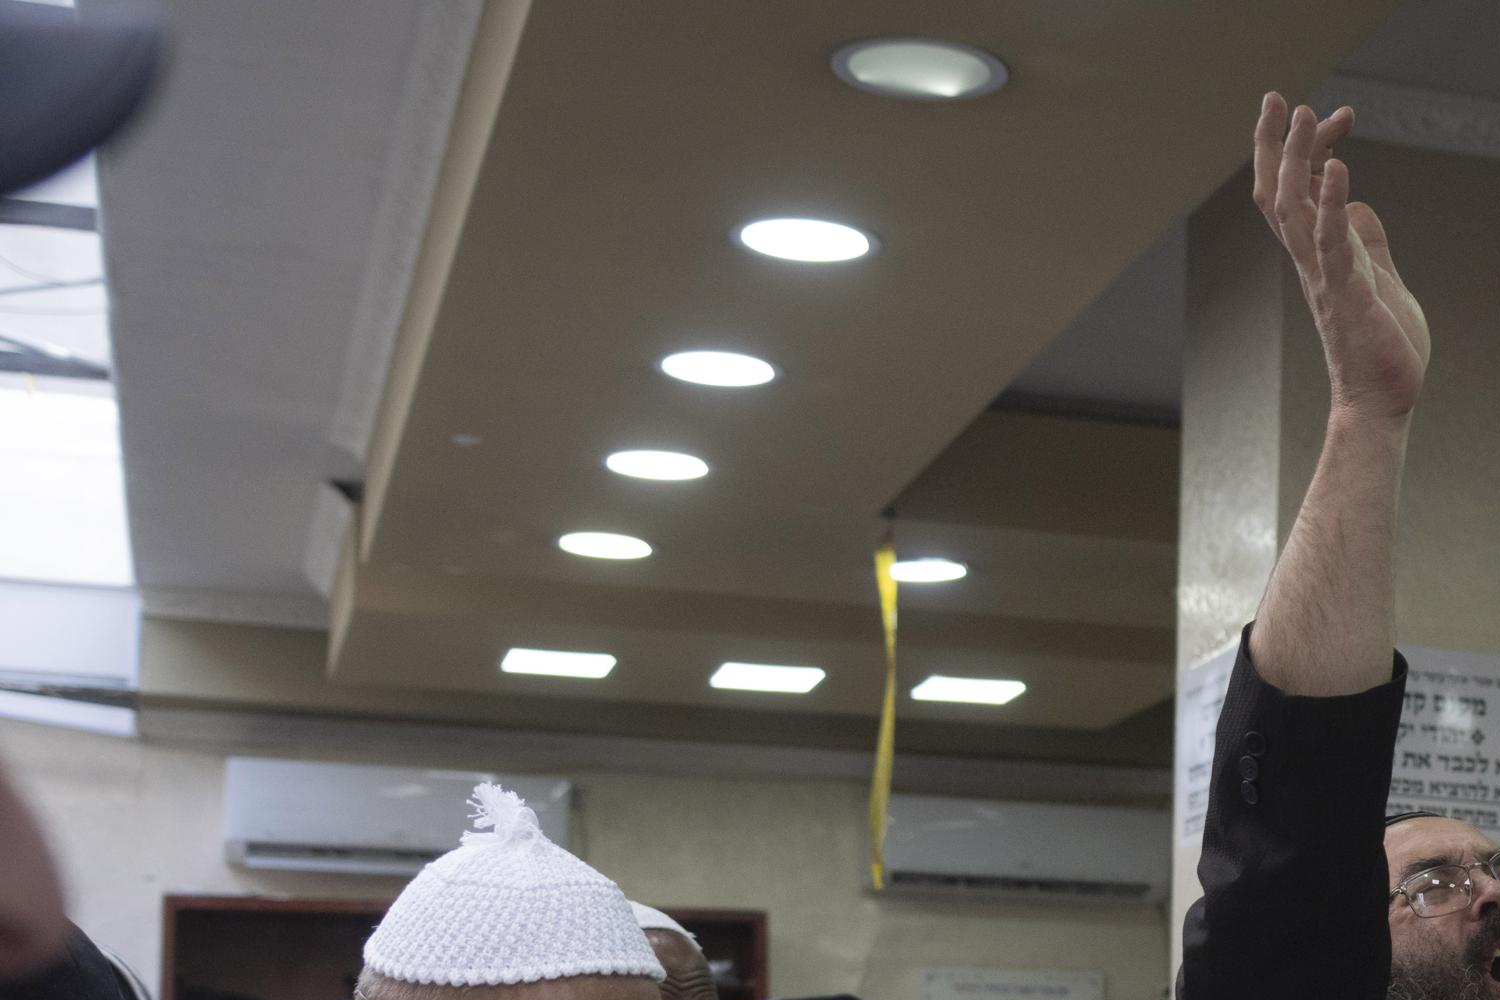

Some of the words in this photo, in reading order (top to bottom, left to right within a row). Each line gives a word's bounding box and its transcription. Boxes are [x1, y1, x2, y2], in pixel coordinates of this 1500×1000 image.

[1401, 750, 1431, 769] את
[1437, 750, 1489, 774] לכבד
[1430, 780, 1489, 799] להוציא
